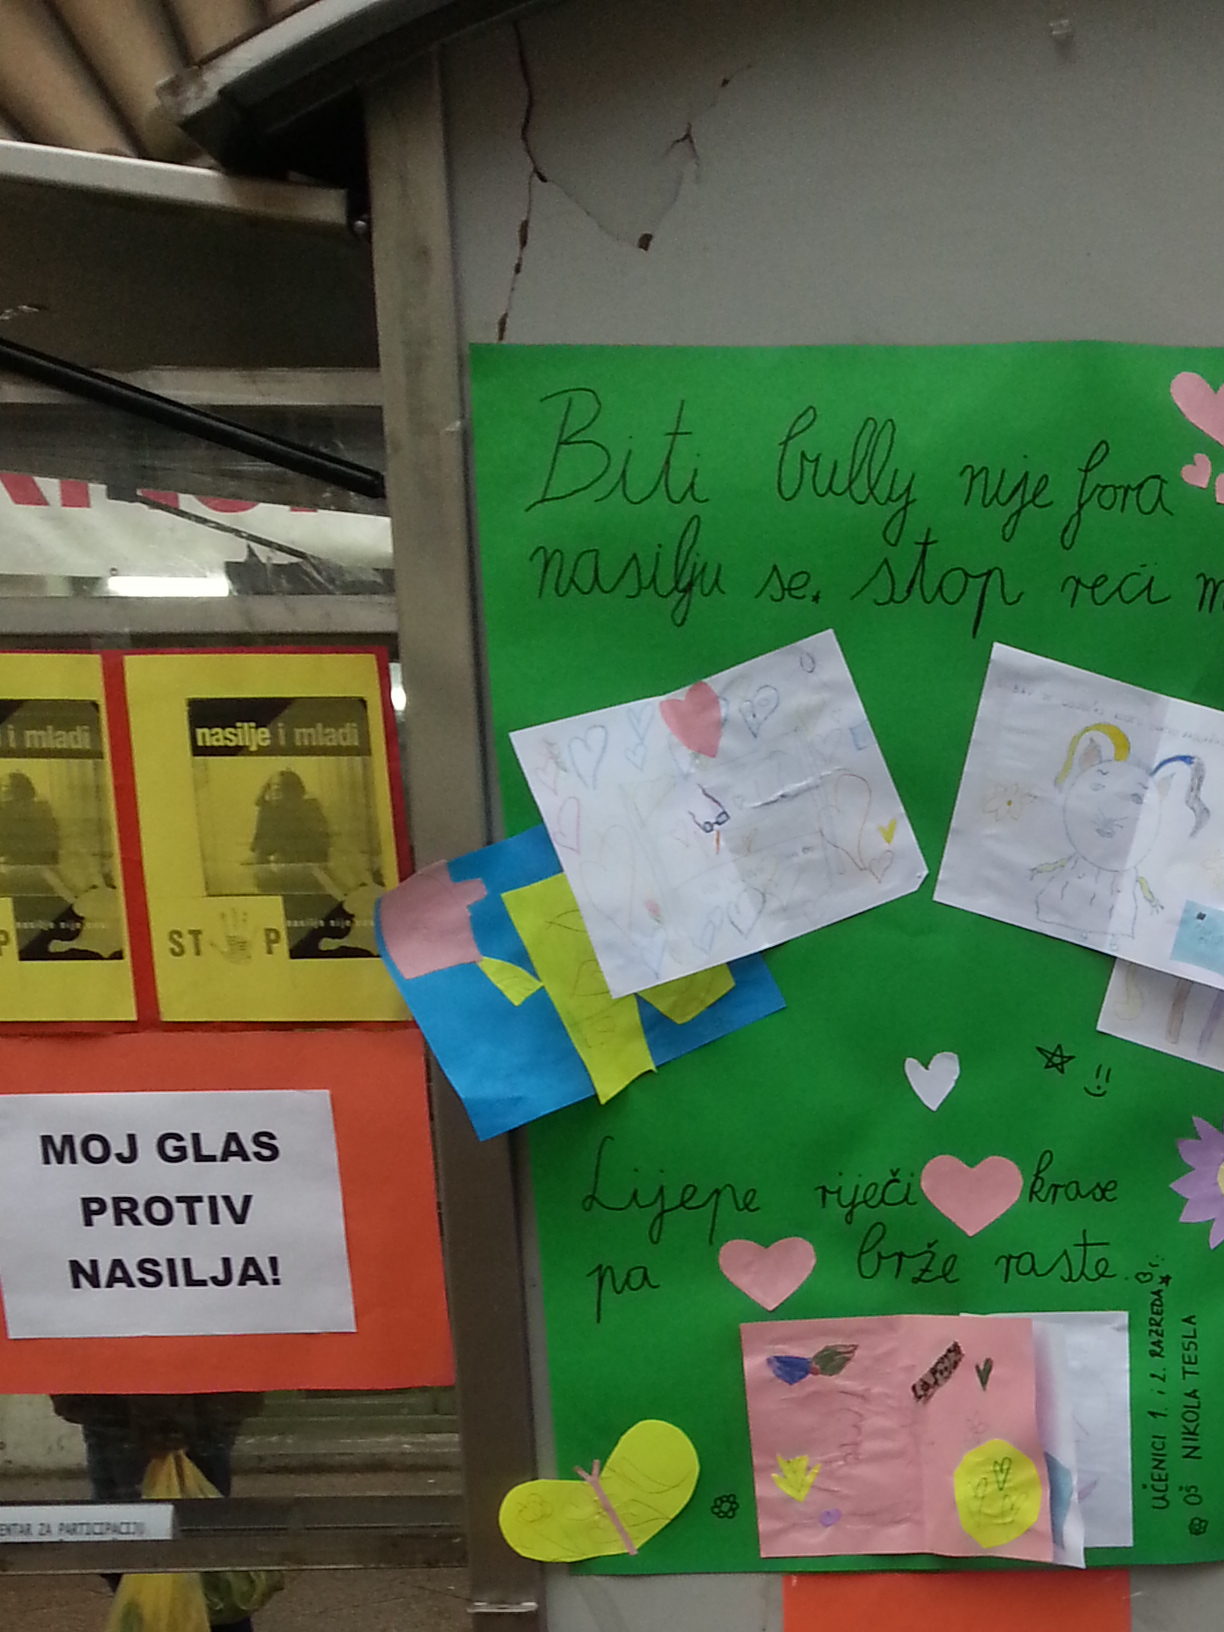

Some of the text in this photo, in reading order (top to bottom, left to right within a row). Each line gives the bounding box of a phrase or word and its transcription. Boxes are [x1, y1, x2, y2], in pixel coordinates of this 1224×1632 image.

[526, 388, 1173, 549] Biti bully nije fora
[529, 516, 726, 627] nasilju
[852, 529, 1022, 638] stop
[24, 725, 92, 751] mladi
[195, 721, 359, 752] nasilje i mladi
[39, 1129, 280, 1166] MOJ GLAS
[81, 1192, 253, 1229] PROTIV
[581, 1136, 760, 1244] Lijepe
[815, 1168, 919, 1225] riječi
[68, 1254, 282, 1291] NASILJA!
[586, 1260, 660, 1324] pa
[856, 1223, 960, 1285] brže
[1181, 1314, 1199, 1380] TESLA
[1181, 1389, 1202, 1460] NIKOLA
[1141, 1435, 1169, 1509] UČENICI
